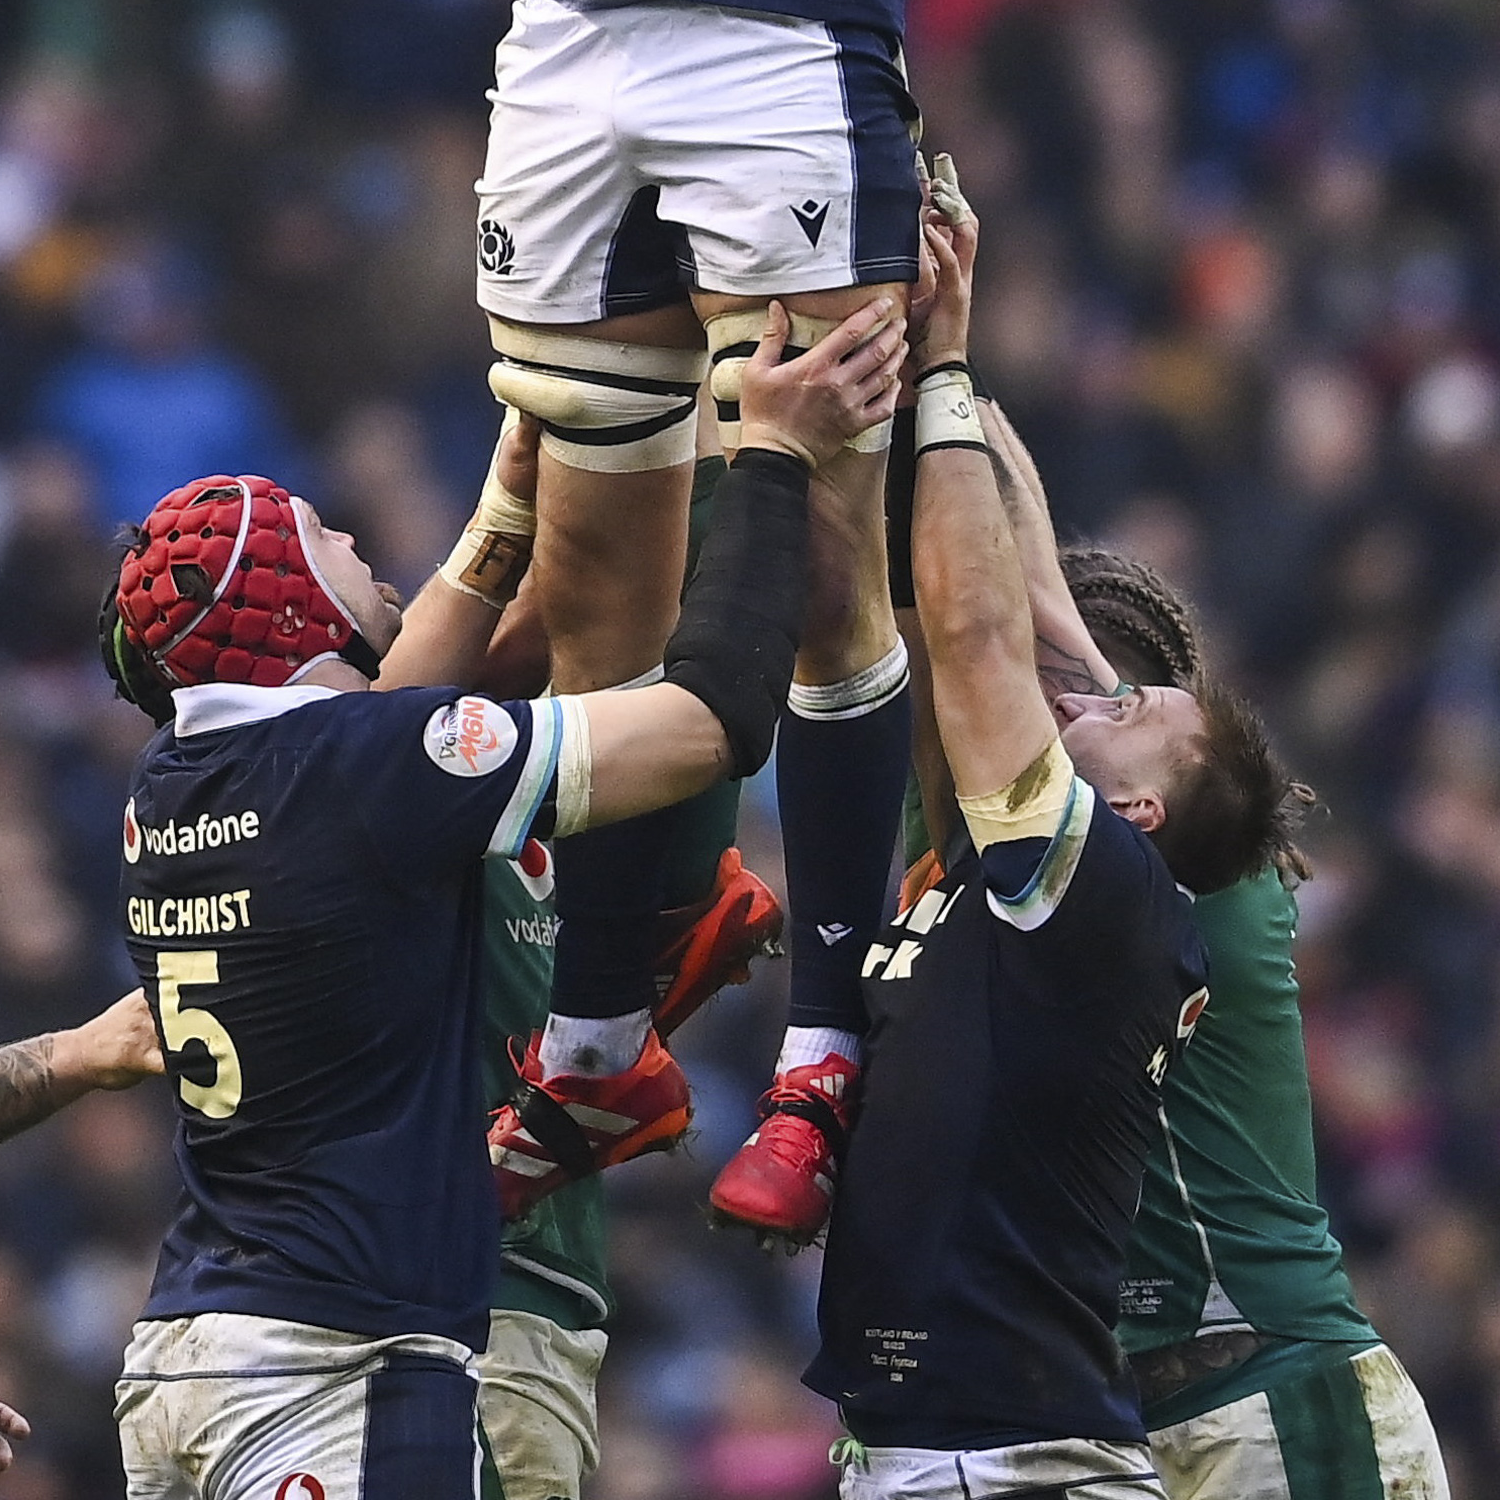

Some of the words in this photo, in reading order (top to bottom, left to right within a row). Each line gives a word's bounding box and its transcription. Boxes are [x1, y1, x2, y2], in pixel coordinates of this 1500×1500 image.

[142, 810, 260, 856] vodafone
[128, 889, 251, 937] GILCHRIST
[156, 950, 243, 1119] 5
